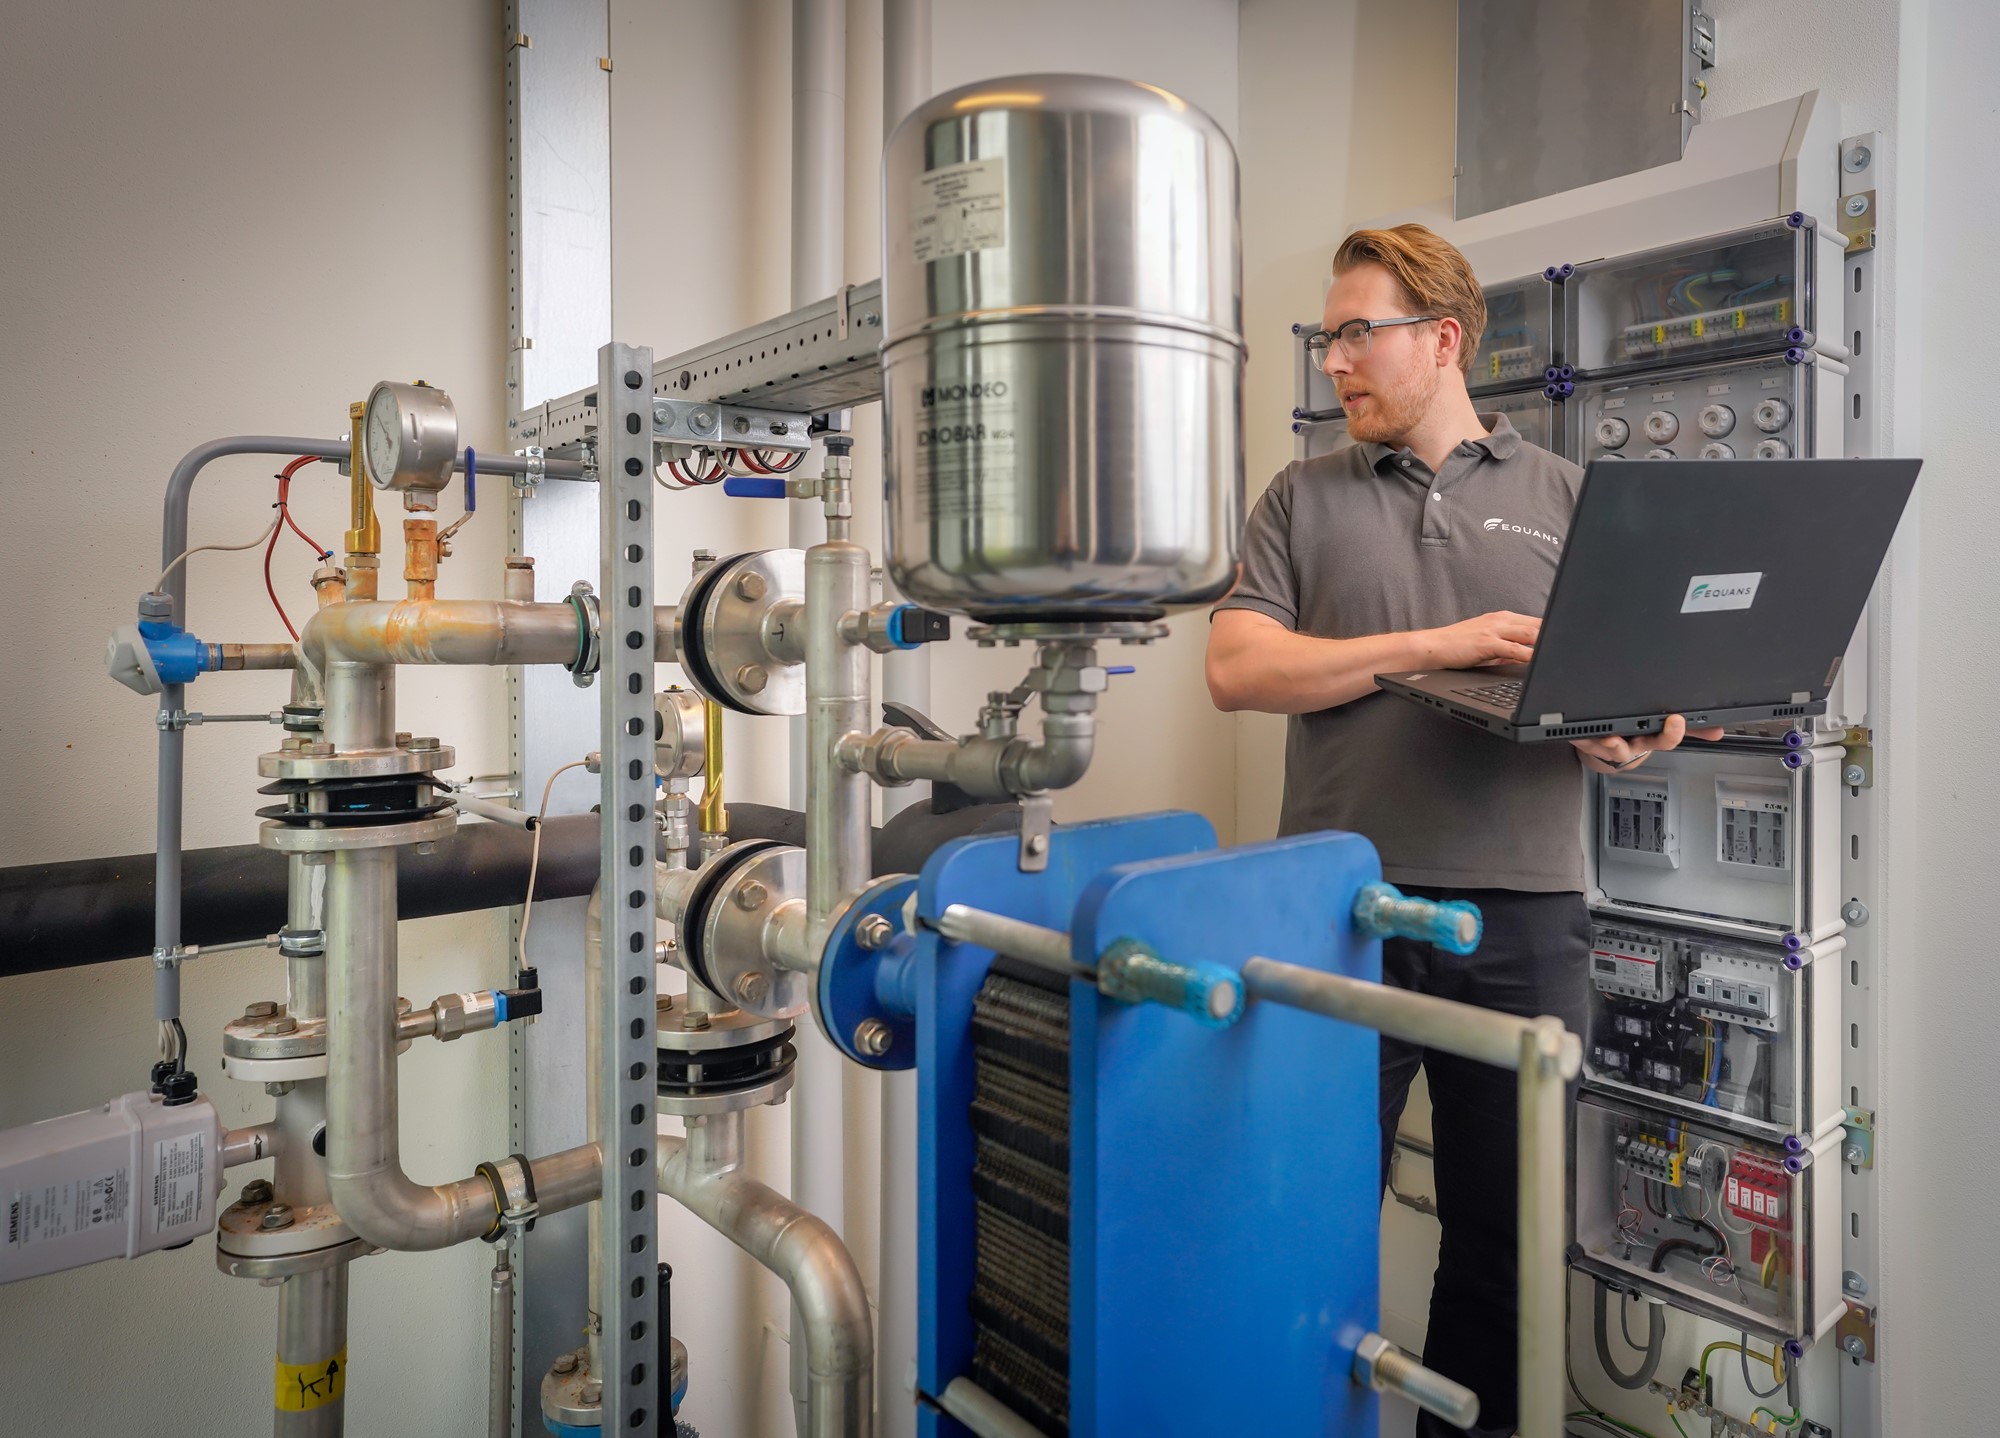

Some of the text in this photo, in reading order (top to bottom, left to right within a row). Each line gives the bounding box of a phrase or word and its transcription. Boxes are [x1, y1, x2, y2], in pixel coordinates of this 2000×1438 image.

[938, 381, 1007, 402] MONDEO
[1501, 523, 1559, 545] EQUANS
[1704, 586, 1751, 598] EQUANS
[8, 1201, 20, 1244] SIEMENS
